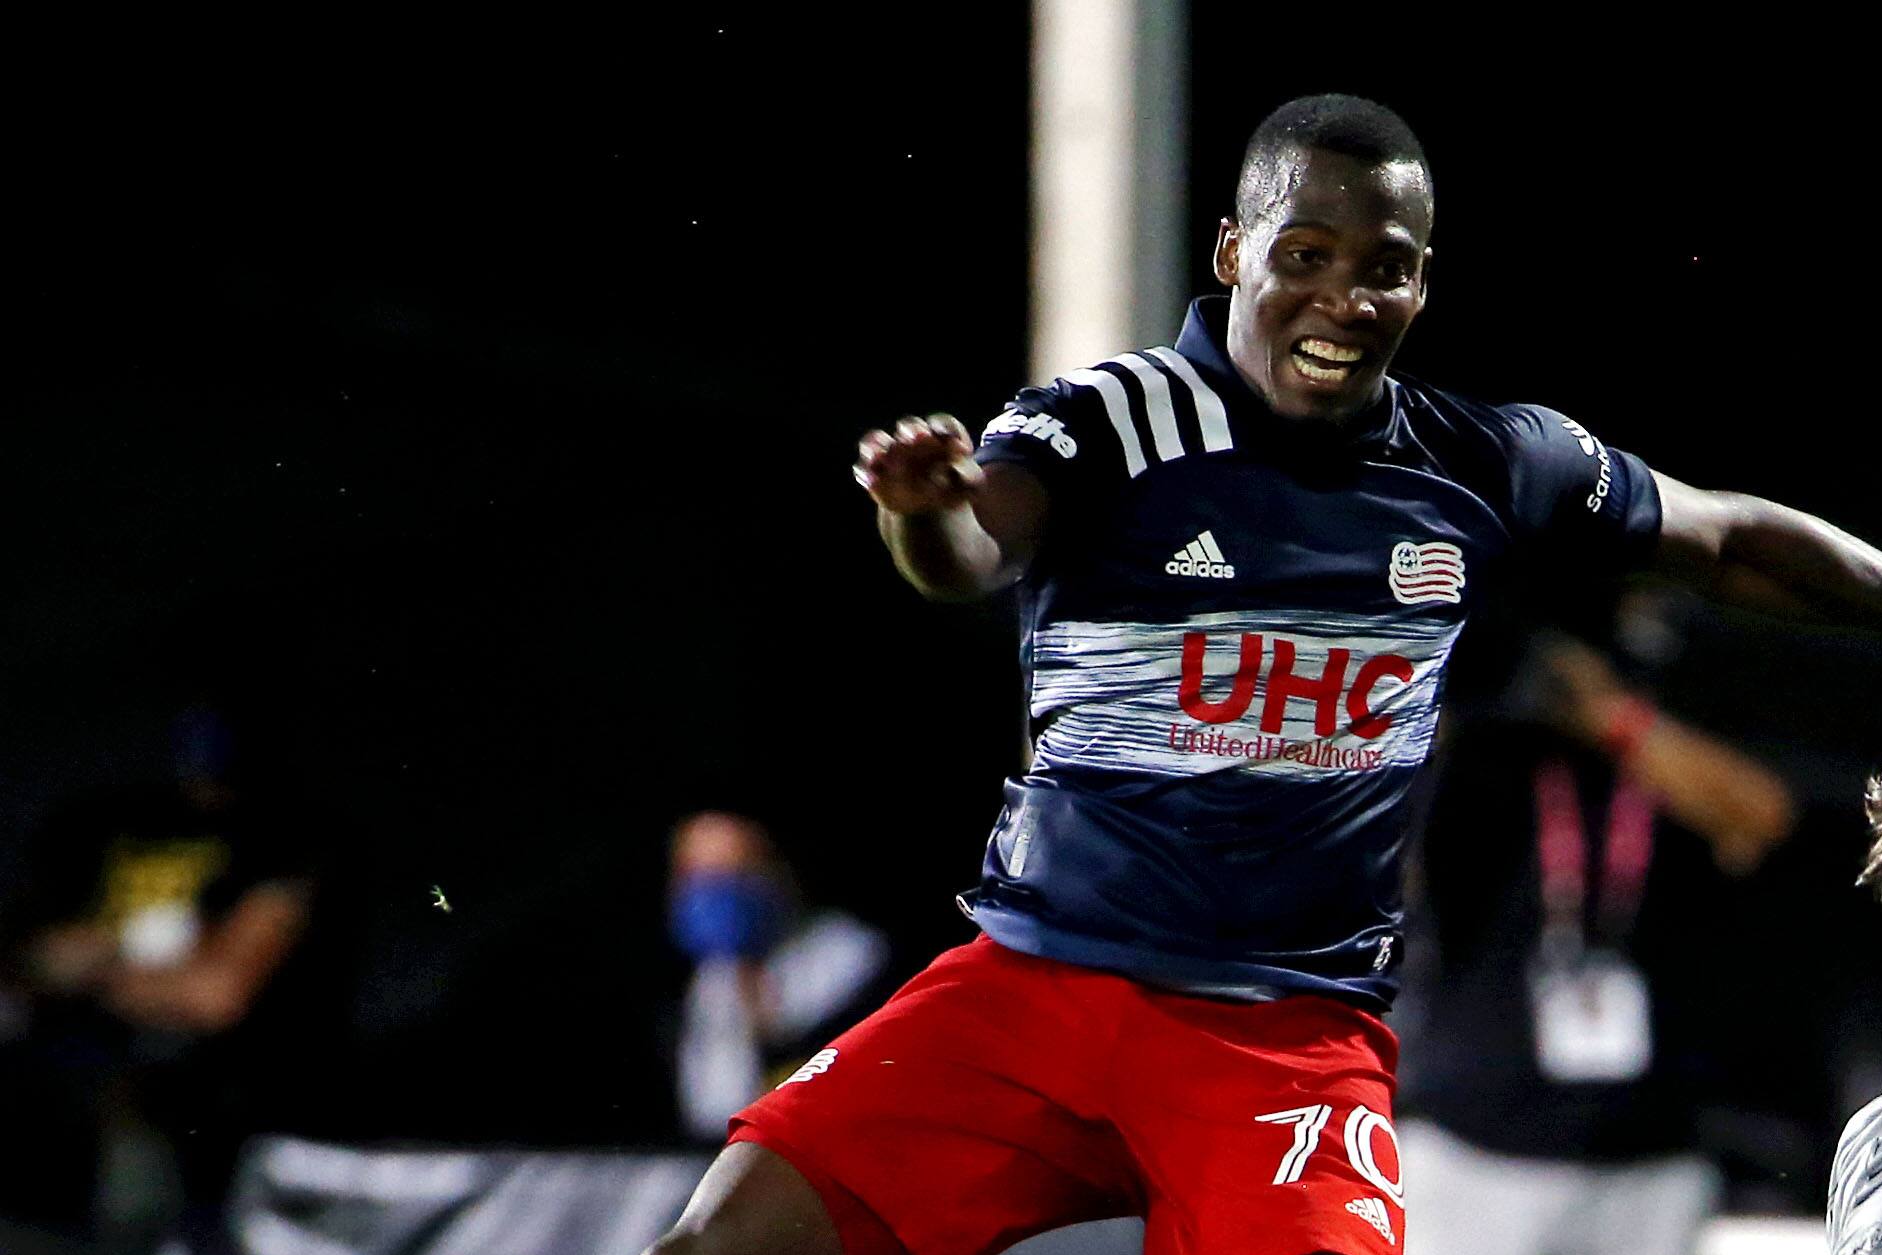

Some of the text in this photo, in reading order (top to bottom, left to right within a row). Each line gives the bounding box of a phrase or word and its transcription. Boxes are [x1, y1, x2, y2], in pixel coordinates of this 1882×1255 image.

[1164, 556, 1236, 579] adidas
[1177, 632, 1415, 740] UHC
[1254, 1103, 1406, 1210] 70
